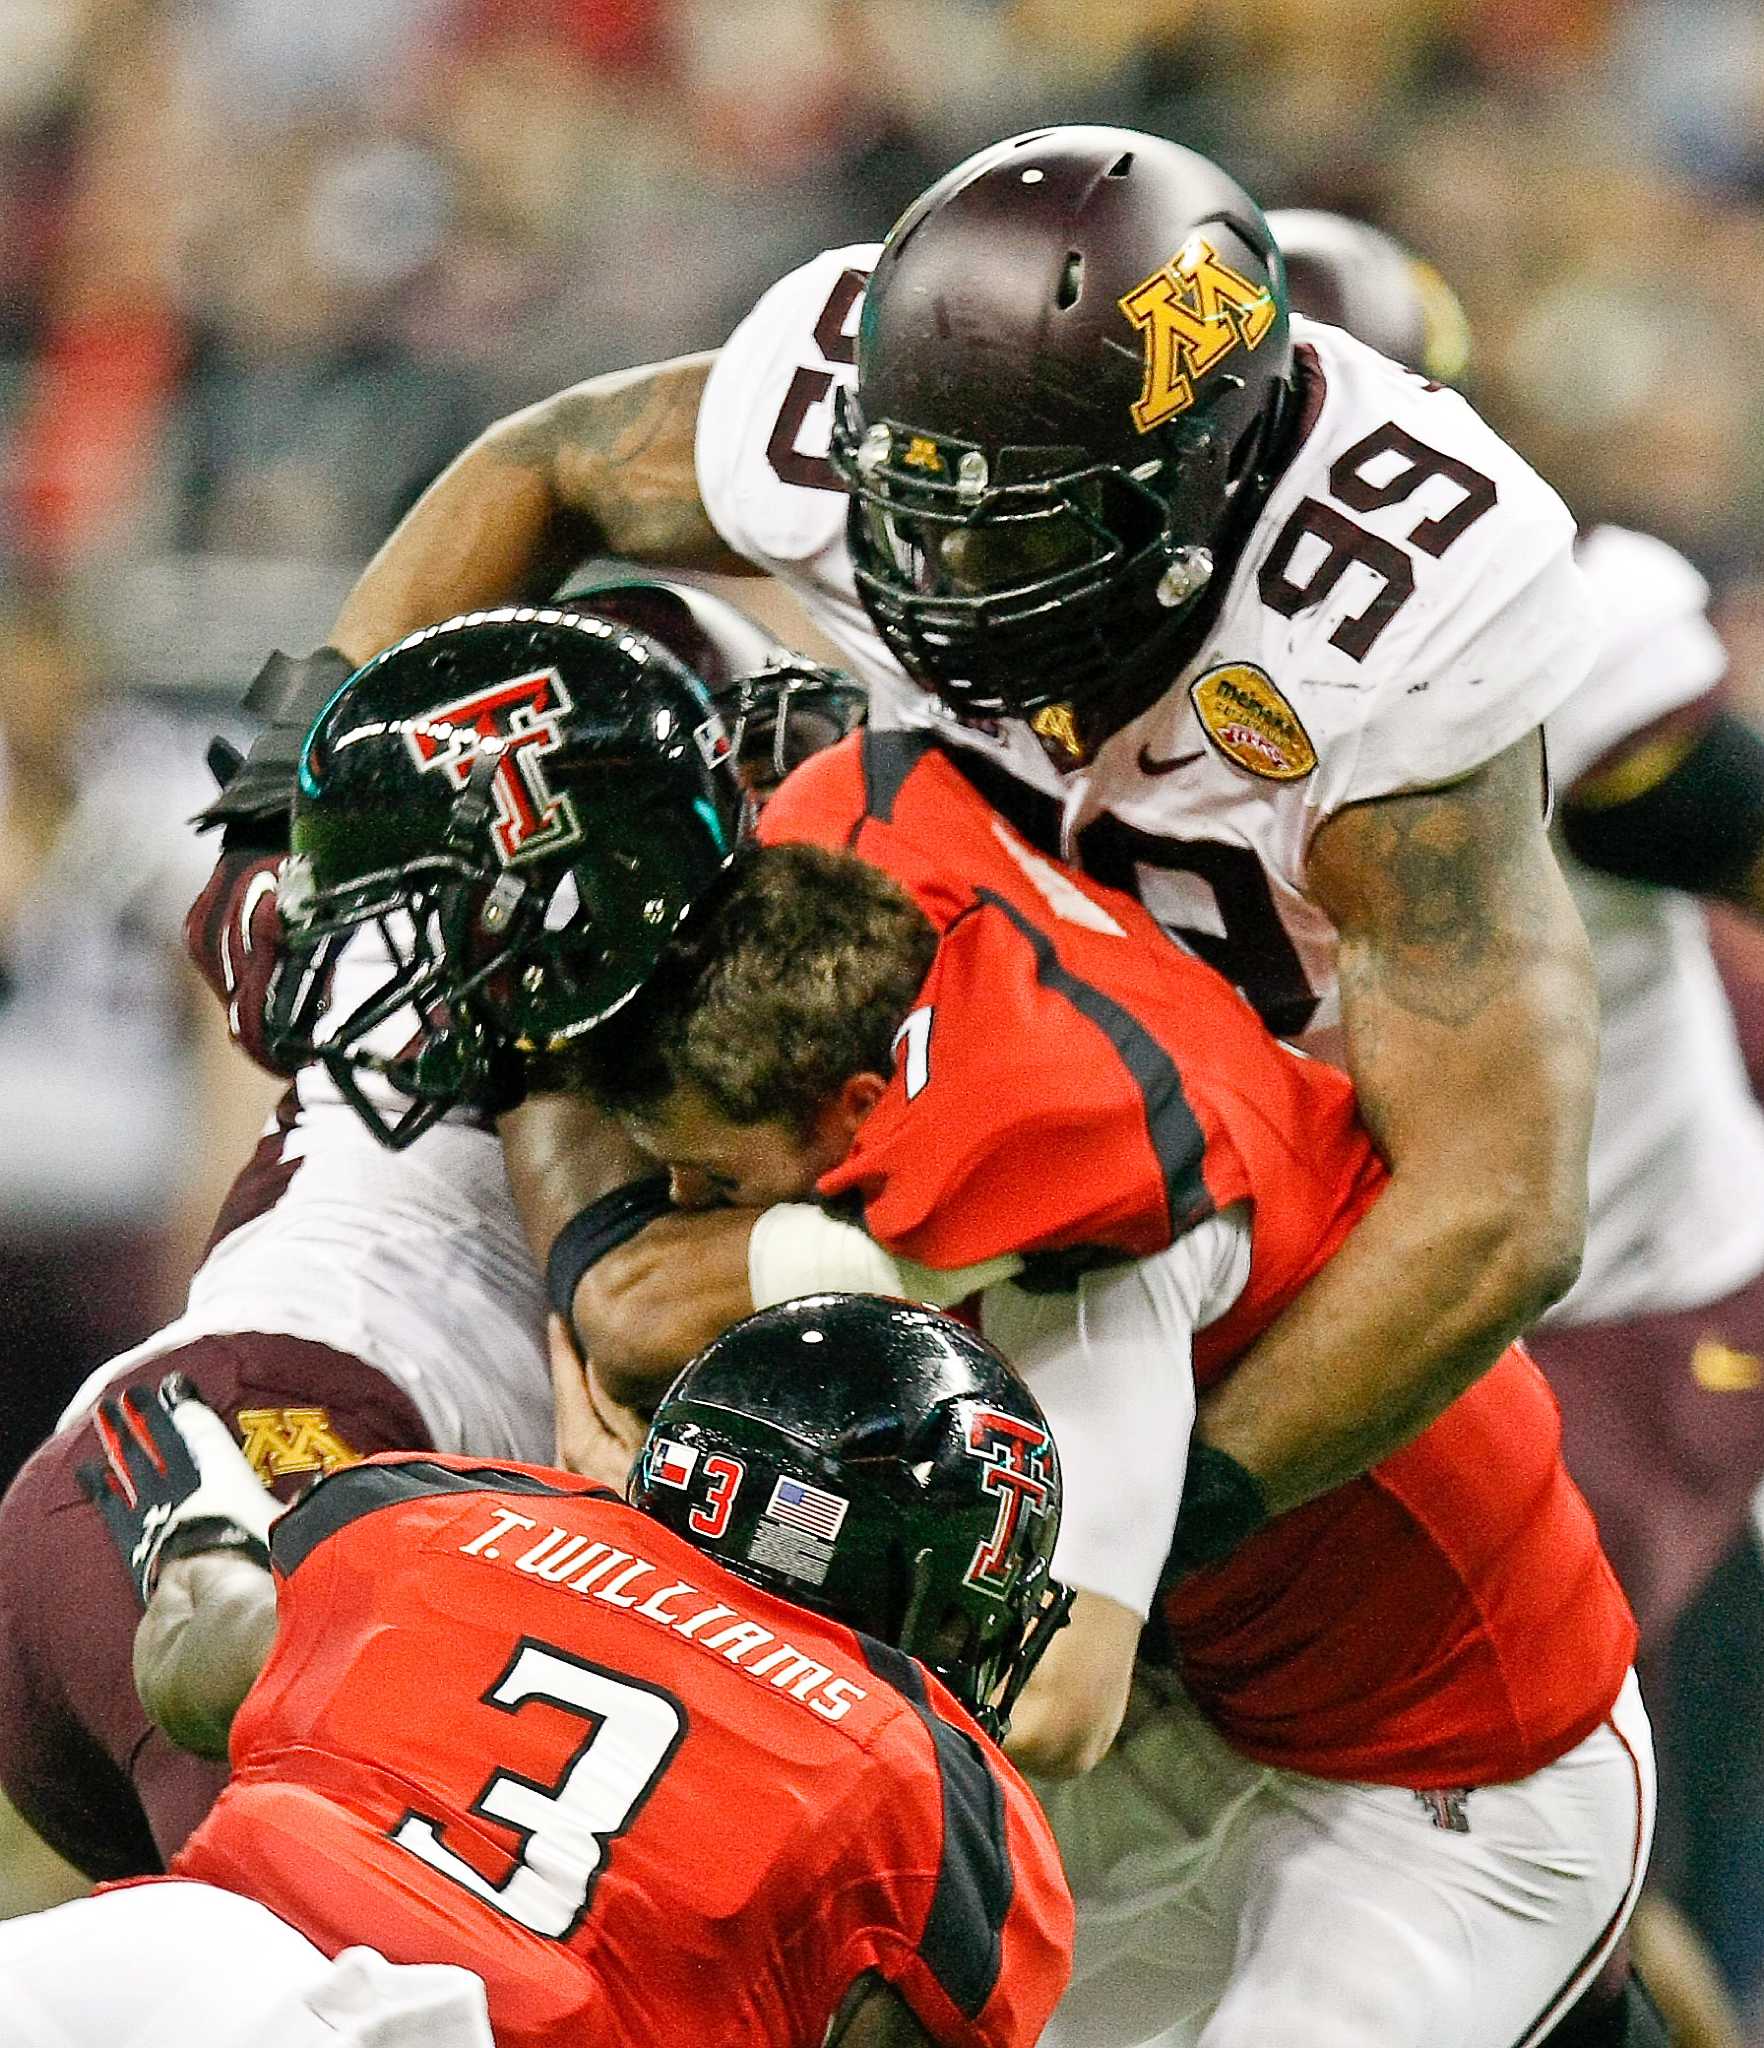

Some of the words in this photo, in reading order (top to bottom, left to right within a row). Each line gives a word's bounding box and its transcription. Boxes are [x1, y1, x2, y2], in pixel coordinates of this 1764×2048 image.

[1258, 421, 1498, 664] 99
[688, 1451, 749, 1539] 3
[458, 1507, 537, 1560] T.
[513, 1526, 867, 1722] WILLIAMS
[391, 1636, 688, 1941] 3
